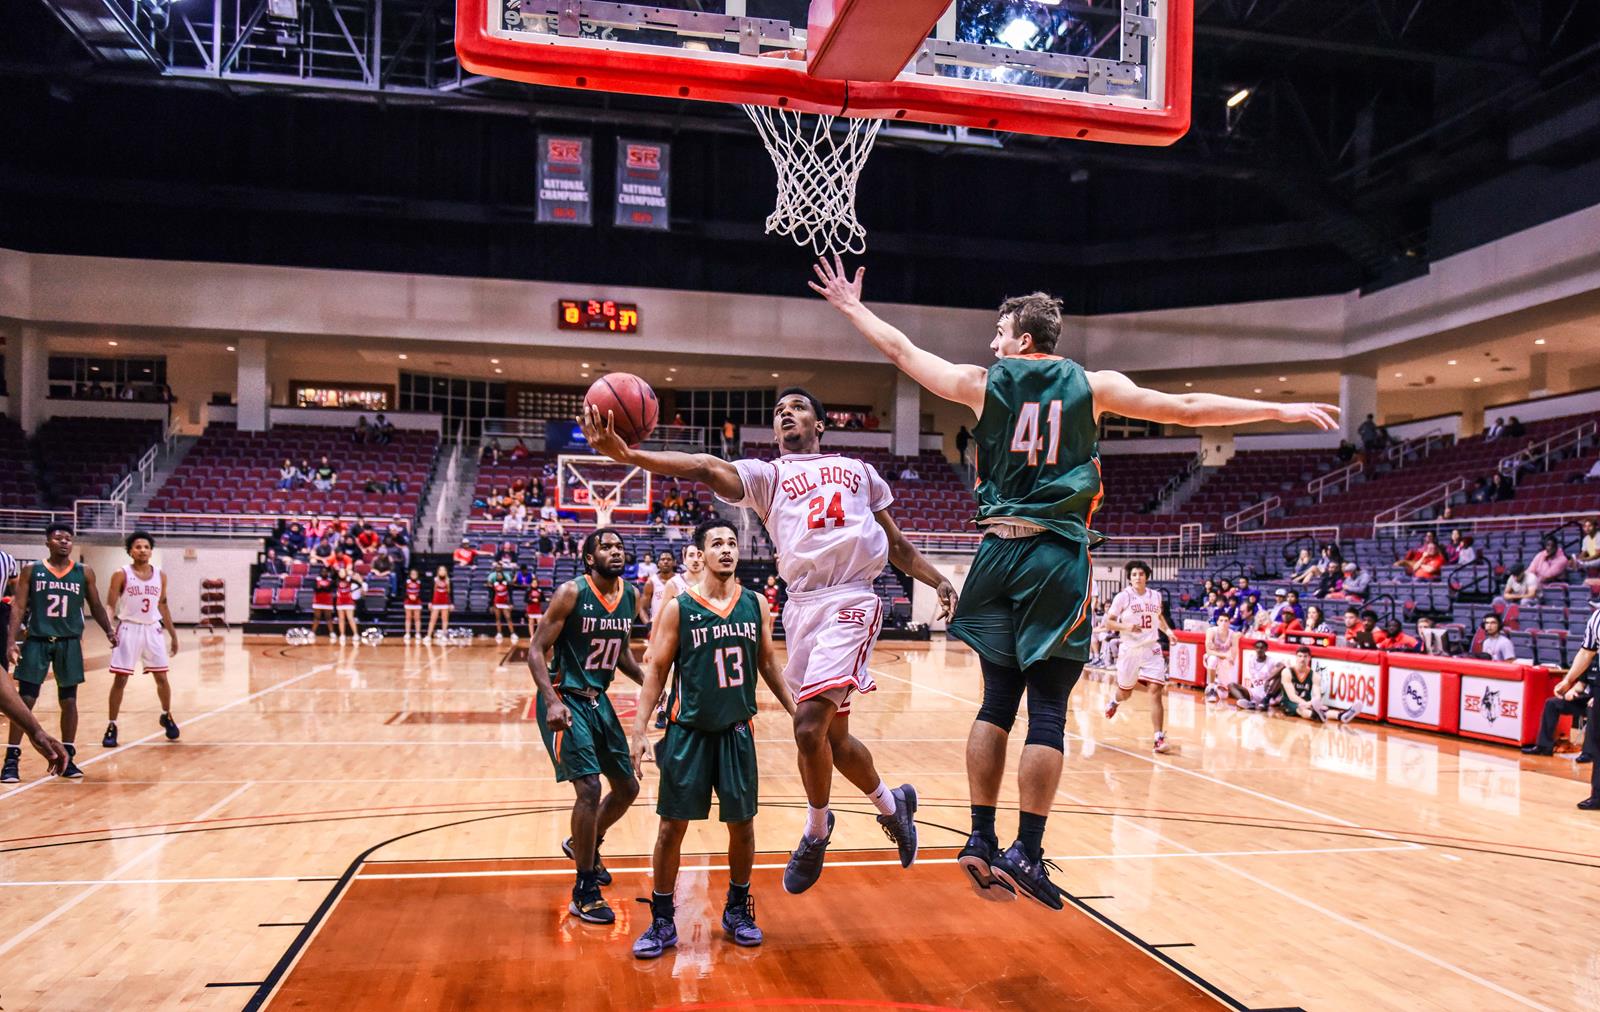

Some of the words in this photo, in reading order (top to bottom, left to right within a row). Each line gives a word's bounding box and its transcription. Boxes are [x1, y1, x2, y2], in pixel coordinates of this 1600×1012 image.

[549, 142, 581, 161] SR
[628, 147, 659, 167] SR
[544, 179, 585, 191] NATIONAL
[622, 183, 662, 197] NATIONAL
[540, 189, 589, 202] CHAMPIONS
[618, 193, 666, 207] CHAMPIONS
[1008, 399, 1063, 467] 41
[781, 472, 817, 501] SUL
[818, 466, 862, 494] ROSS
[807, 492, 845, 530] 24
[36, 580, 47, 592] UT
[49, 580, 80, 595] DALLAS
[127, 585, 143, 597] SUL
[47, 594, 68, 618] 21
[141, 598, 150, 613] 3
[582, 617, 597, 633] UT
[837, 608, 866, 625] SR
[1140, 614, 1152, 629] 12
[691, 628, 708, 649] UT
[712, 622, 757, 643] DALLAS
[584, 638, 622, 670] 20
[714, 646, 744, 688] 13
[1329, 671, 1376, 707] LOBOS
[1406, 685, 1422, 706] ASC
[1465, 696, 1481, 712] SR
[1501, 701, 1518, 718] SR
